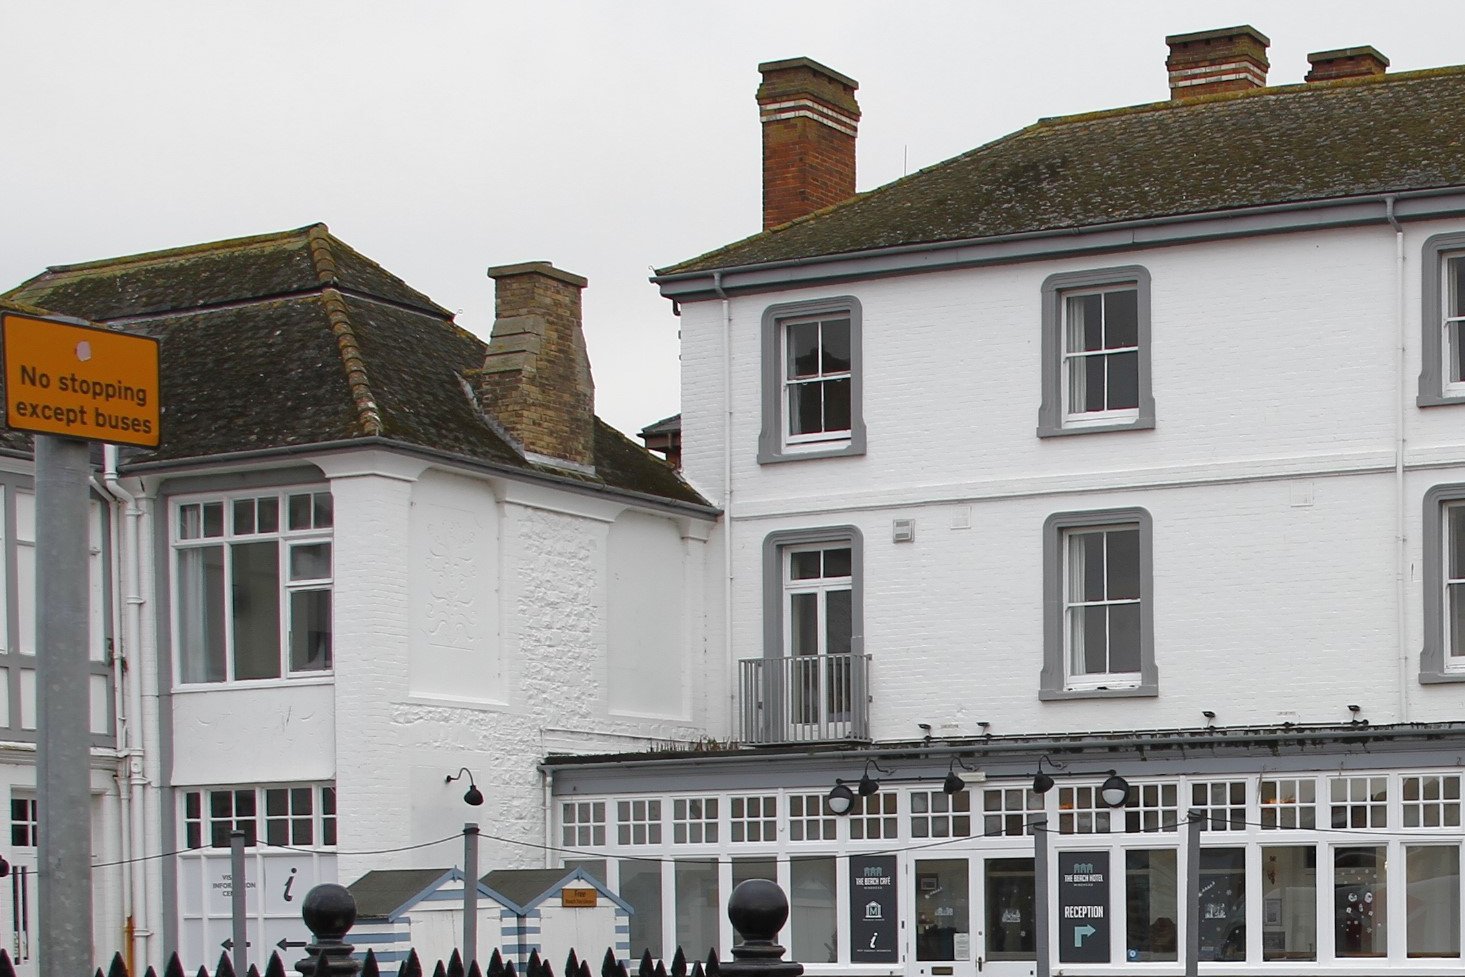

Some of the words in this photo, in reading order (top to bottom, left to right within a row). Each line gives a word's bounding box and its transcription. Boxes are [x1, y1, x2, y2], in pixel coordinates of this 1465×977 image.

[20, 364, 51, 389] No
[58, 373, 147, 407] stopping
[16, 401, 88, 427] except
[95, 407, 152, 434] buses
[1064, 905, 1104, 918] RECEPTION
